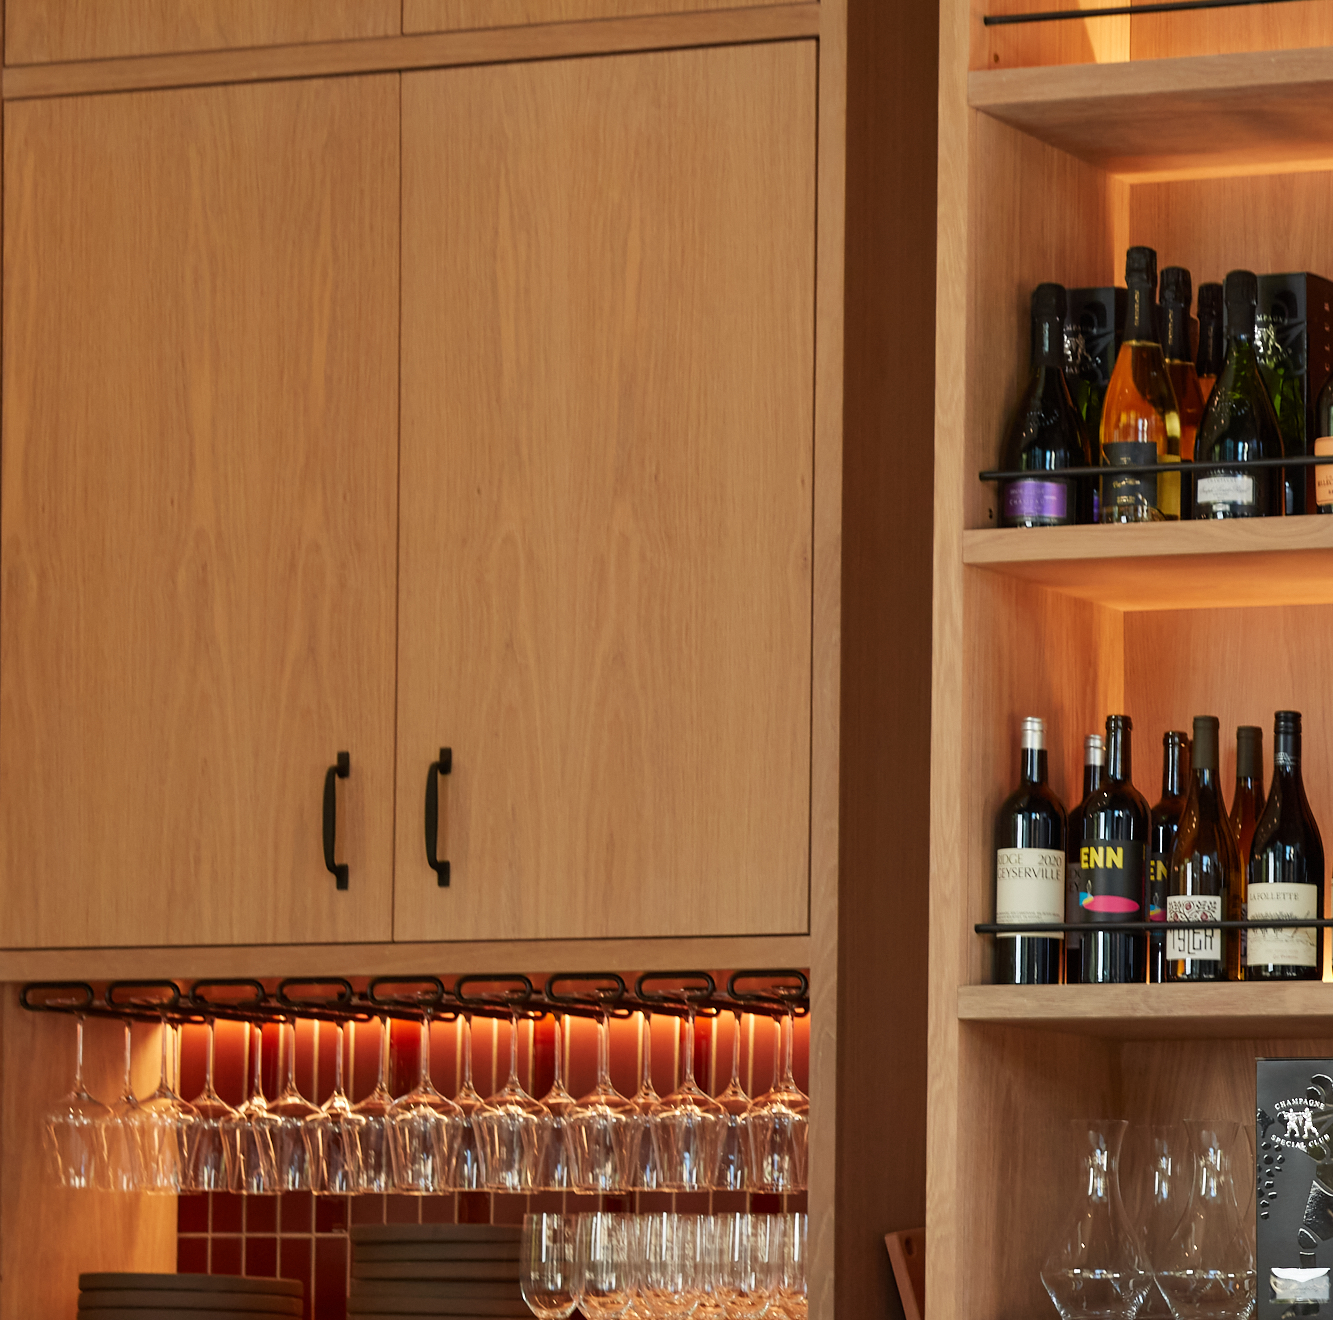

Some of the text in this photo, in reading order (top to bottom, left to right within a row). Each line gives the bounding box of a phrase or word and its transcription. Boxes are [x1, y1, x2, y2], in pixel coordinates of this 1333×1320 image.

[1038, 853, 1062, 867] 2020
[1080, 846, 1123, 870] ENN
[997, 866, 1062, 880] GEYSERVILLE
[1273, 1097, 1326, 1112] CHAMPAGNE
[1270, 1132, 1331, 1150] SPECIAL CLUB
